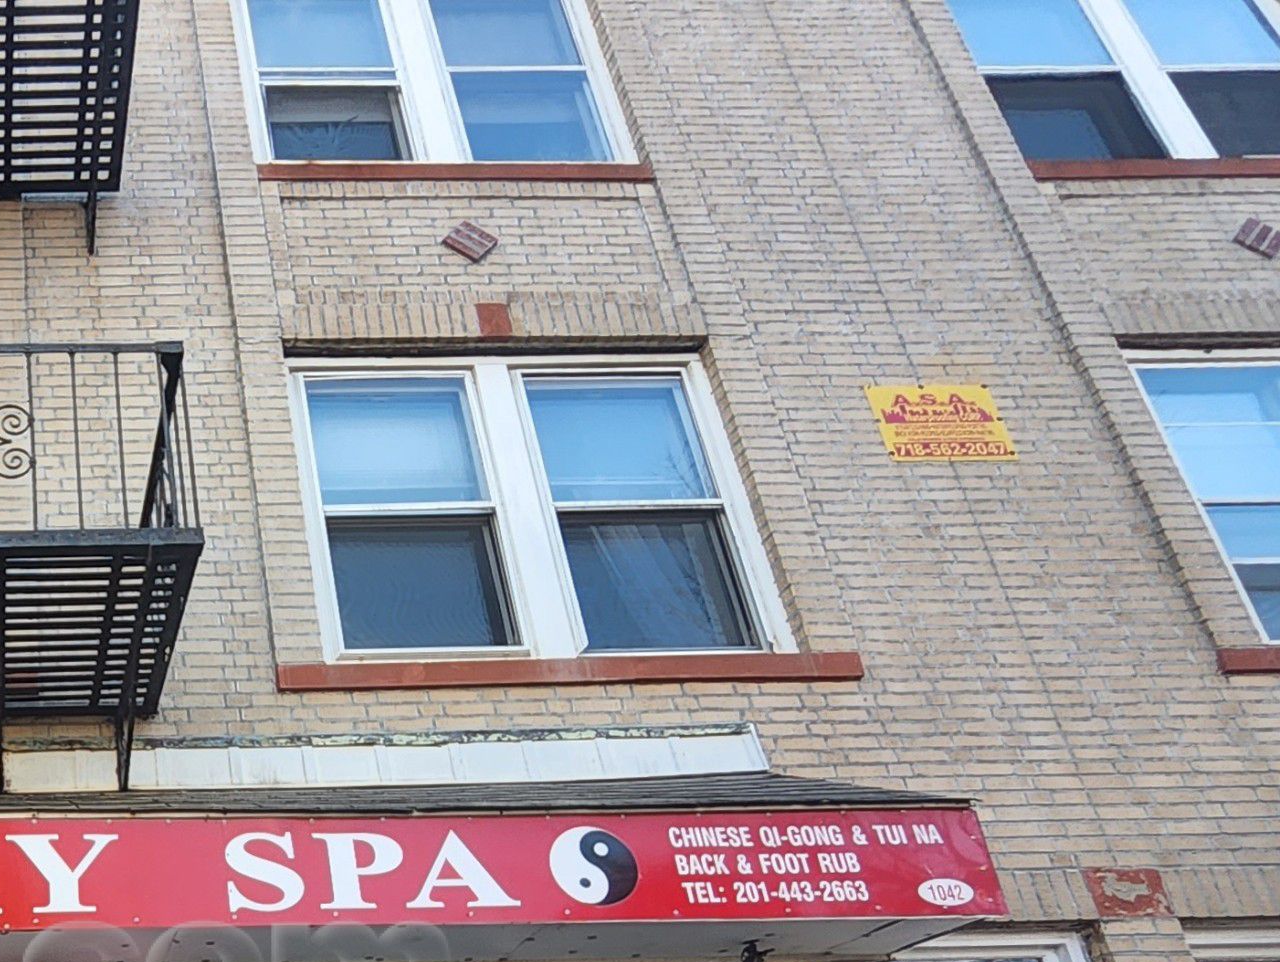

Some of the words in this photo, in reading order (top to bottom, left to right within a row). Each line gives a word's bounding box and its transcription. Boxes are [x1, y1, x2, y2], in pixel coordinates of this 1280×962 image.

[895, 442, 1005, 456] 718-562-2047
[668, 826, 754, 848] CHINESE
[759, 825, 843, 848] QI-GONG
[852, 825, 869, 845] &
[872, 824, 908, 845] TUI
[914, 824, 945, 844] NA
[224, 829, 522, 913] SPA
[674, 854, 730, 876] BACK
[736, 853, 754, 875] &
[759, 853, 811, 875] FOOT
[819, 852, 862, 874] RUB
[681, 881, 727, 904] TEL:
[733, 880, 870, 904] 201-443-2663
[927, 883, 966, 902] 1042
